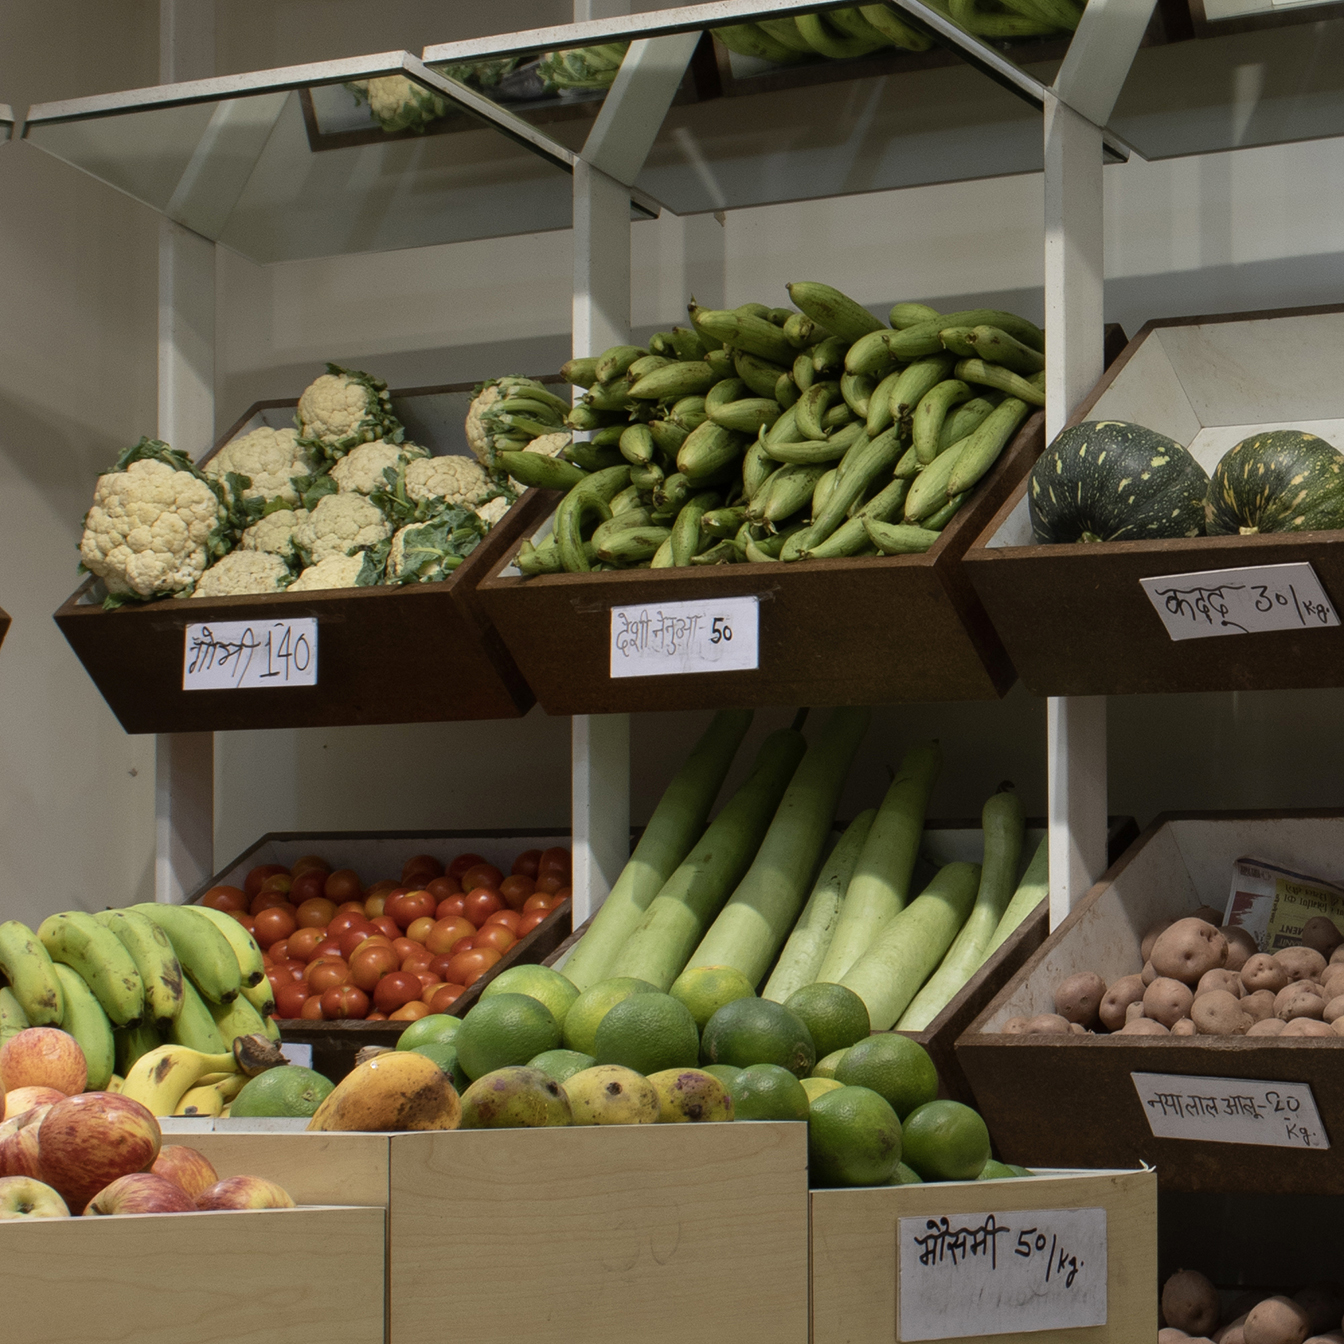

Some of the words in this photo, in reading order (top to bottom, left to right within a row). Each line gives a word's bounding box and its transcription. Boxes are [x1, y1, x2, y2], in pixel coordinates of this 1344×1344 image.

[709, 617, 733, 644] 50
[1147, 1092, 1184, 1118] नया
[1185, 1095, 1219, 1118] लाल
